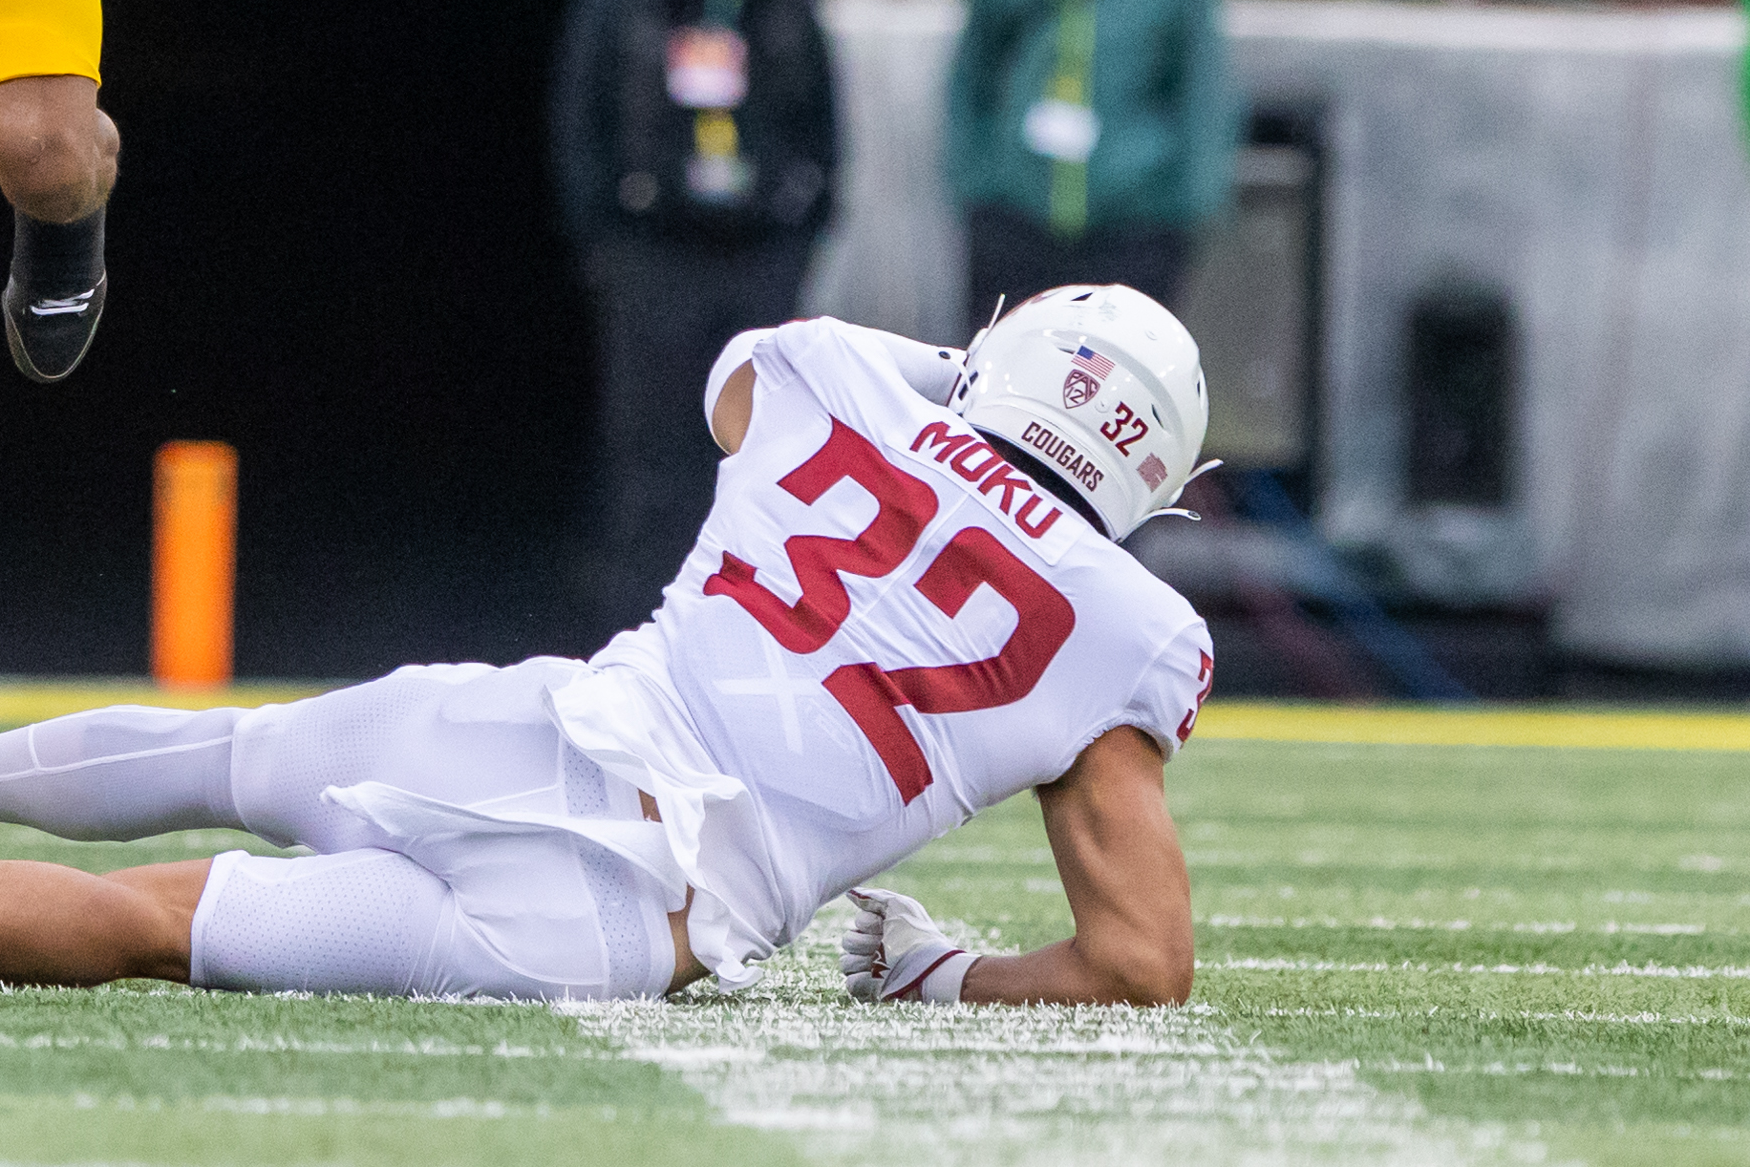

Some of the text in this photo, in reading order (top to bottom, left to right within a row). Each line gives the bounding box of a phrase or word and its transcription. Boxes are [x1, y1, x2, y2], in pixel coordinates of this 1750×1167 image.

[1065, 370, 1099, 402] PAC
[1065, 386, 1085, 404] 12
[1021, 421, 1104, 492] COUGARS
[1100, 401, 1149, 457] 32
[909, 421, 1063, 539] MOKU
[703, 413, 1076, 807] 32
